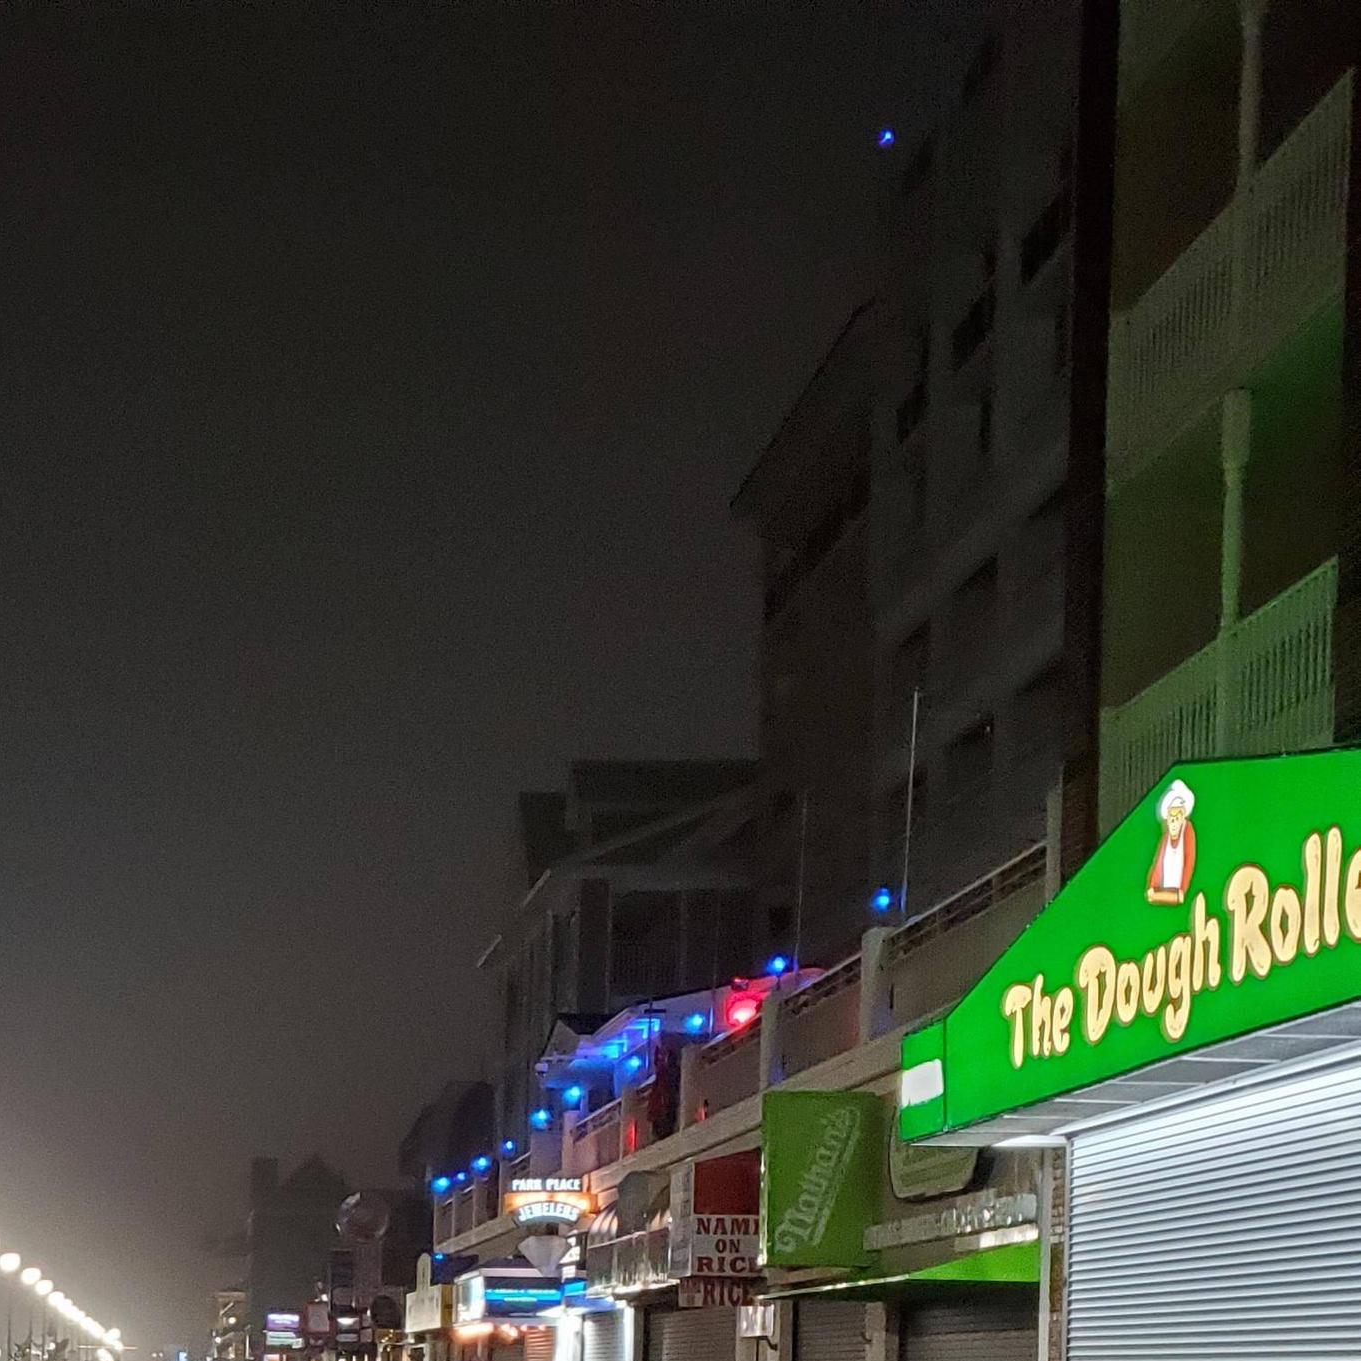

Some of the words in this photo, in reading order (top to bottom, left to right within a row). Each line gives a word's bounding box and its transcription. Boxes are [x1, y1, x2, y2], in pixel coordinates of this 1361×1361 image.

[1003, 974, 1074, 1070] The
[1079, 892, 1221, 1043] Dough
[512, 1178, 542, 1191] PARK
[545, 1178, 581, 1191] PLACE
[518, 1202, 580, 1222] JEWELERS
[715, 1238, 740, 1254] ON
